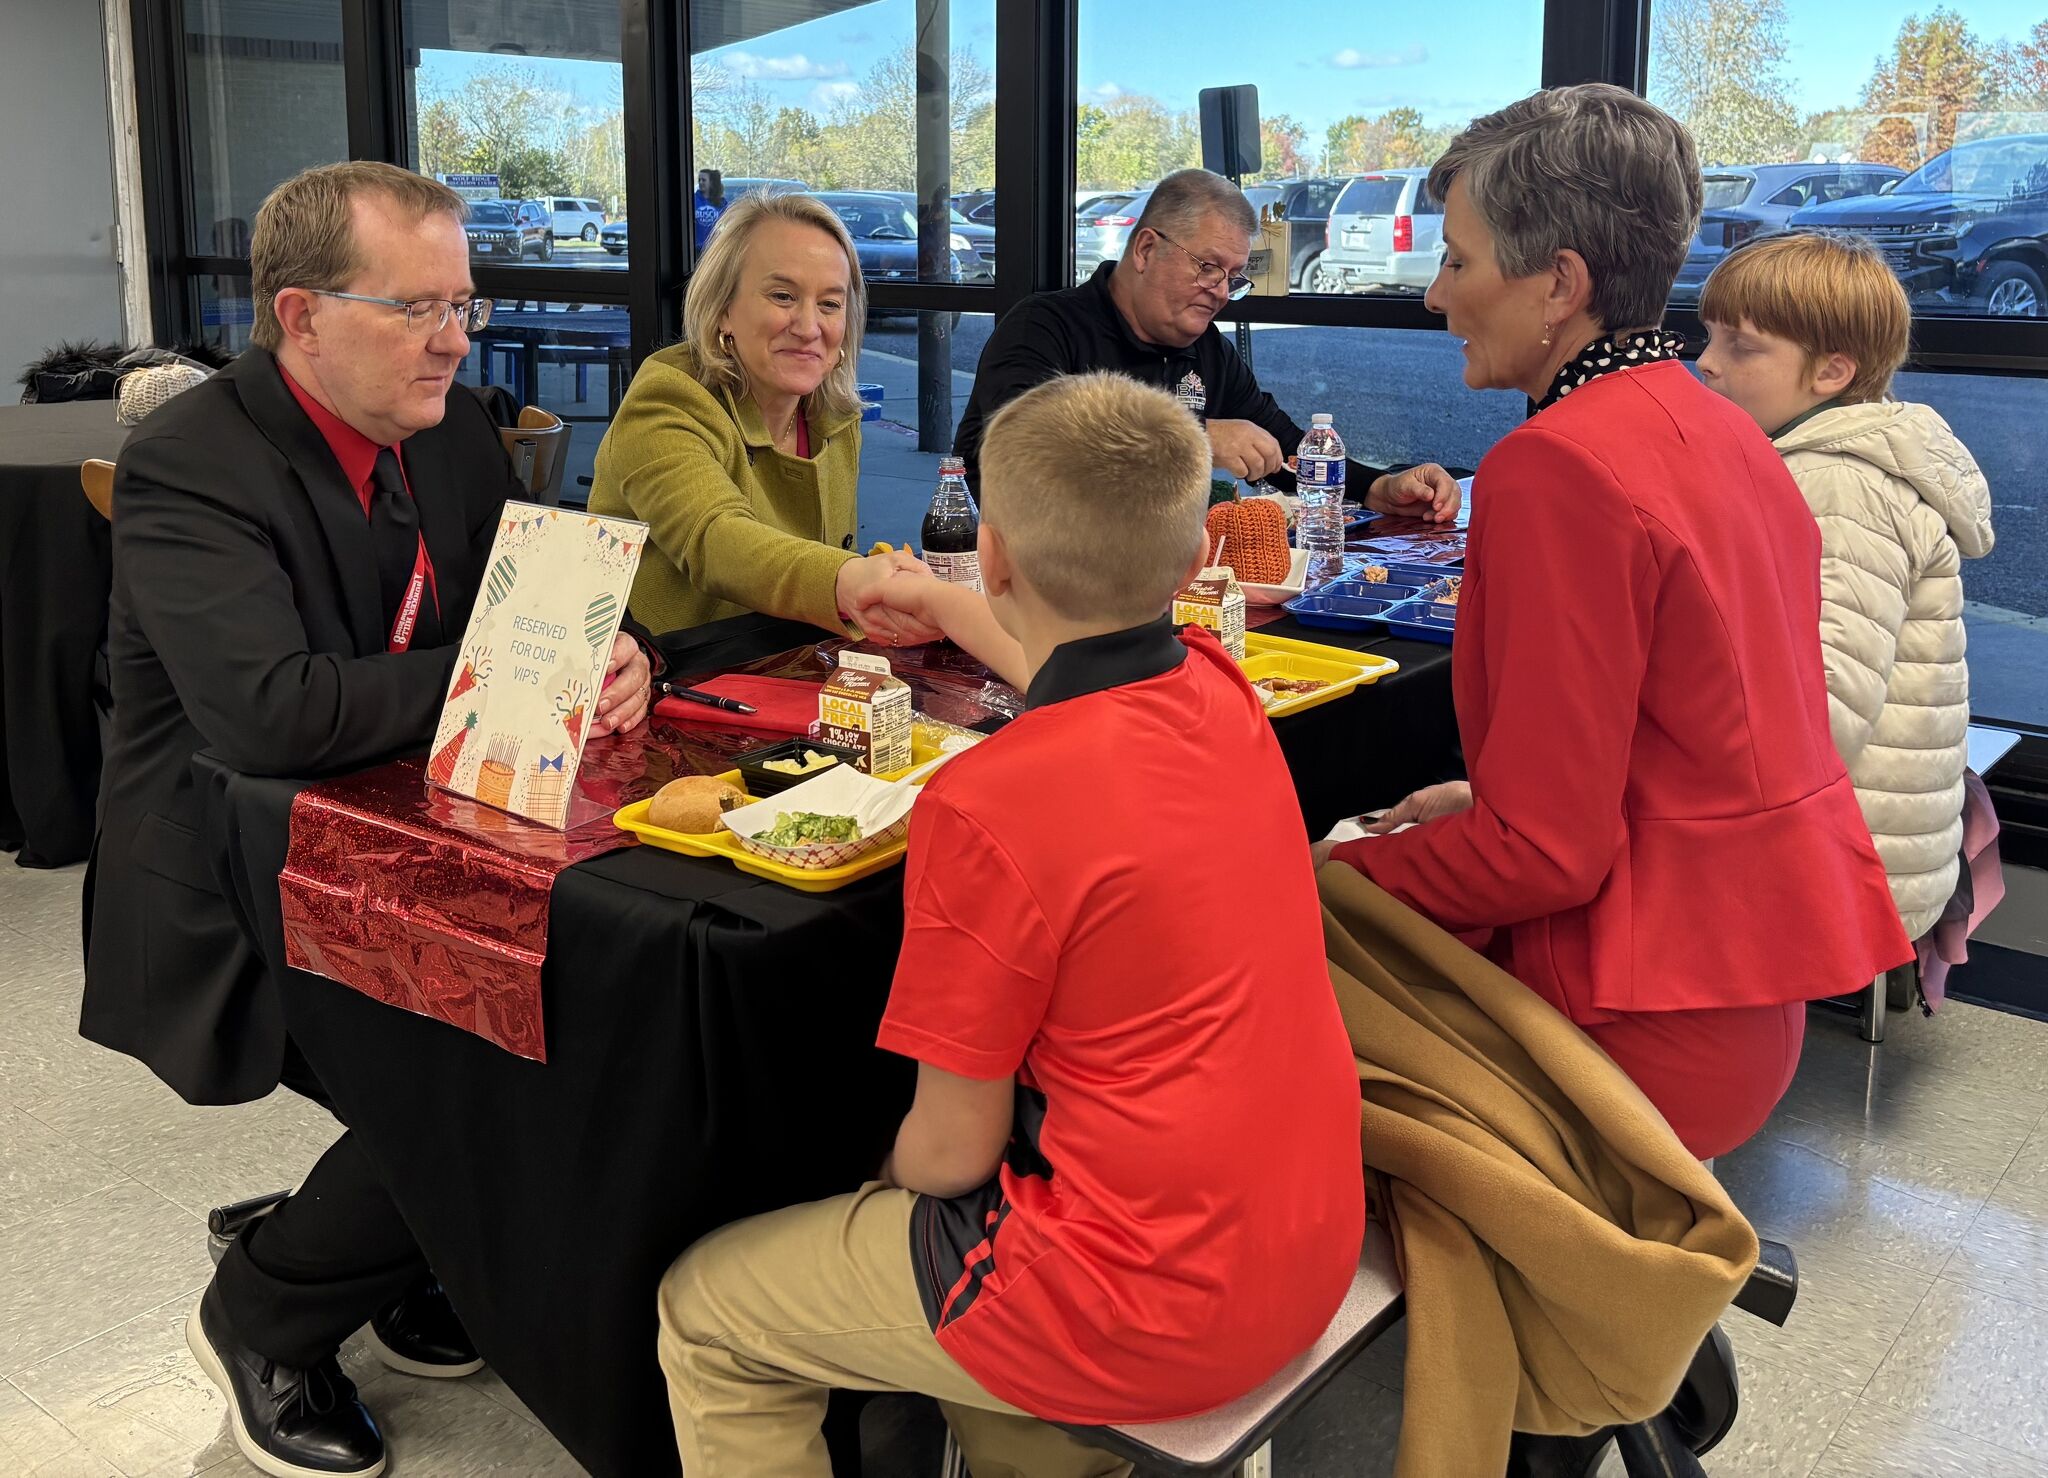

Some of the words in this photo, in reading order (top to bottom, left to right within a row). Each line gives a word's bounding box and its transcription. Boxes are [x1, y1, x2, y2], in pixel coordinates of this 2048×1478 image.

[1176, 604, 1217, 616] LOCAL
[513, 615, 567, 640] RESERVED
[510, 640, 532, 657] FOR
[533, 646, 557, 664] OUR
[514, 666, 540, 685] VIP'S
[822, 696, 866, 716] LOCAL
[823, 710, 867, 730] FRESH
[828, 727, 844, 741] 1%
